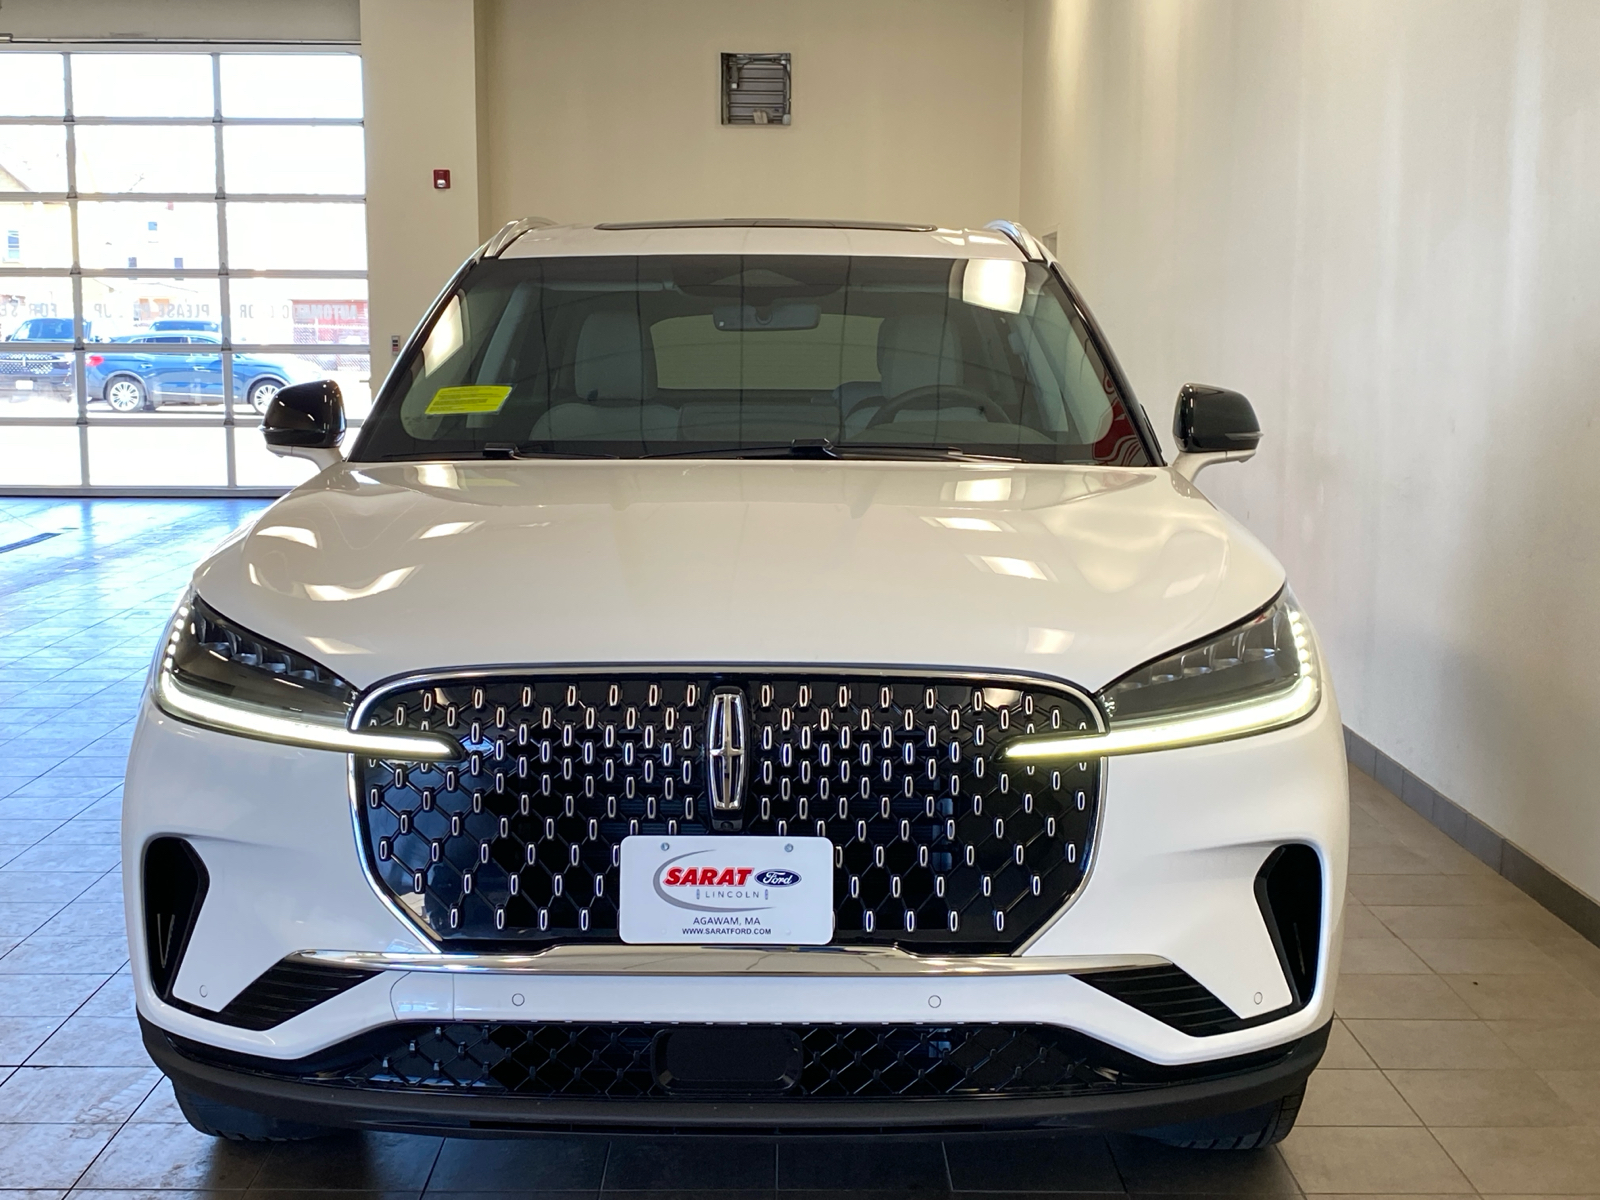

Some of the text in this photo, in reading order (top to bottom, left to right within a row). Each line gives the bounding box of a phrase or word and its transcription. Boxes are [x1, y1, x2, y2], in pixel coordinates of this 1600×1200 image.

[663, 867, 793, 887] SARAT Ford
[705, 890, 760, 899] LINCOLN
[693, 917, 761, 926] AGAWAM, MA
